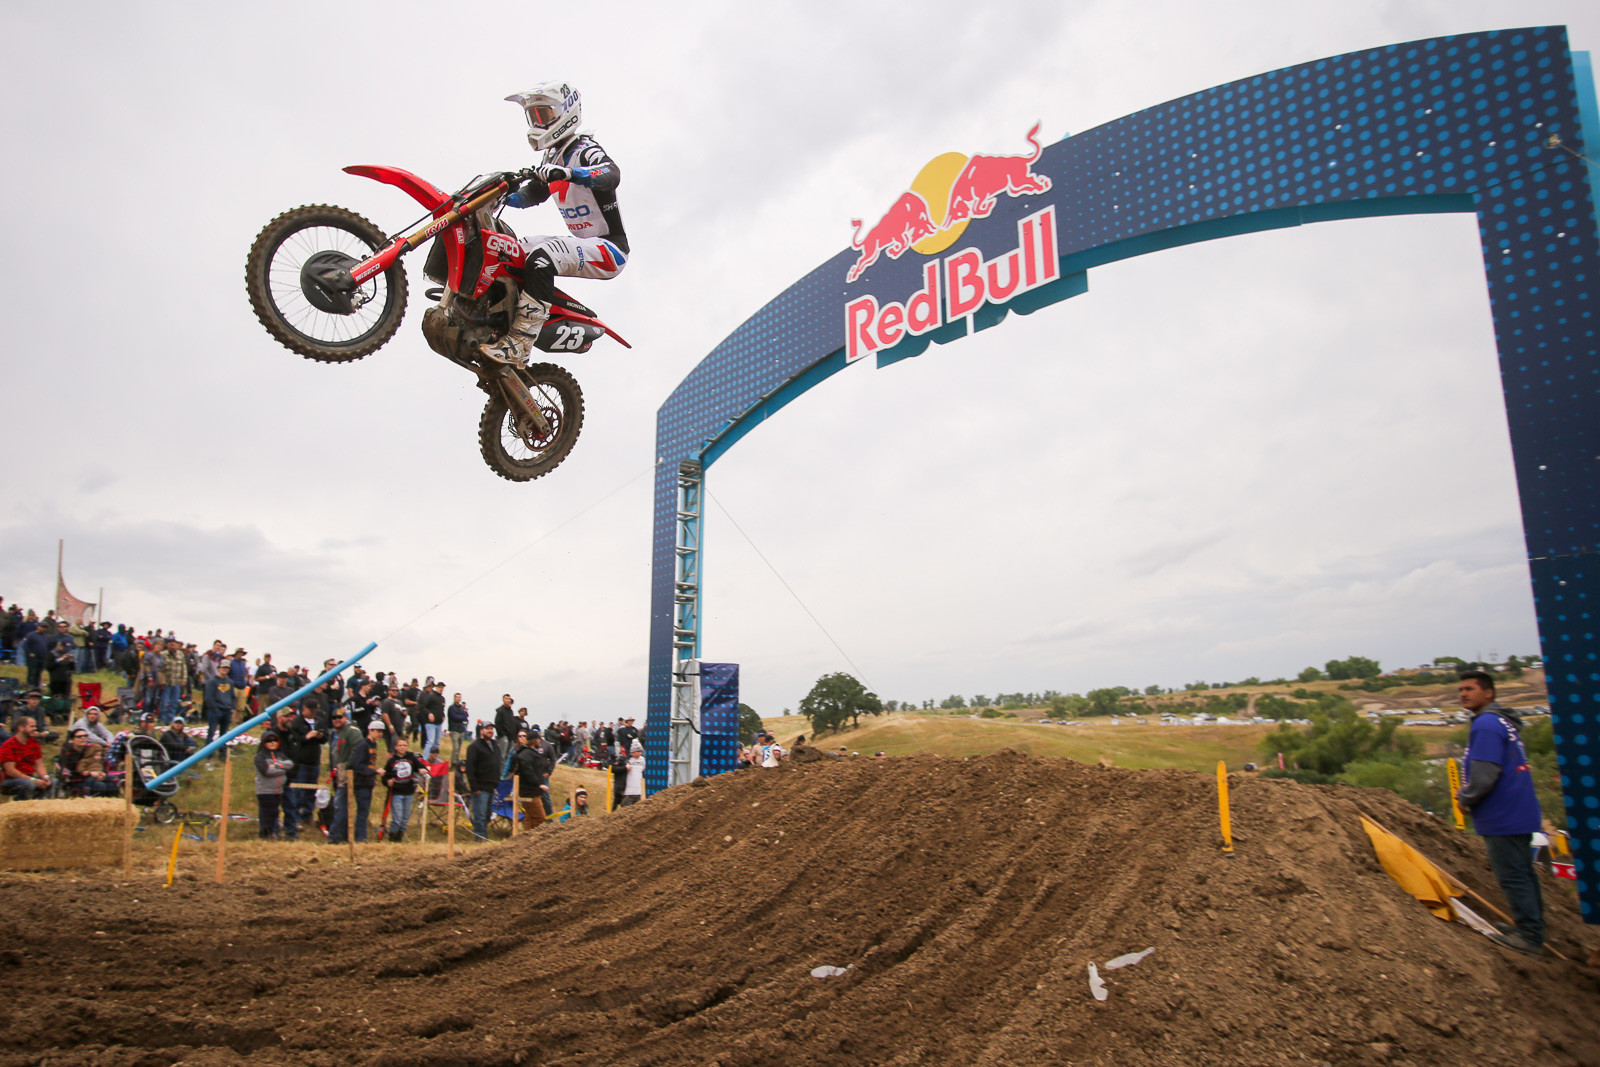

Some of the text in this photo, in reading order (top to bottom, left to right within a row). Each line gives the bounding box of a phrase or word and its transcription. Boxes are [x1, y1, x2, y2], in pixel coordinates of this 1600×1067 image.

[560, 83, 571, 100] 23
[552, 115, 579, 140] GEICO
[559, 204, 590, 219] EICO
[425, 217, 449, 238] KYB
[486, 235, 520, 258] GEICO
[846, 208, 1057, 361] Red Bull
[566, 301, 587, 312] HONDA
[550, 325, 586, 350] 23
